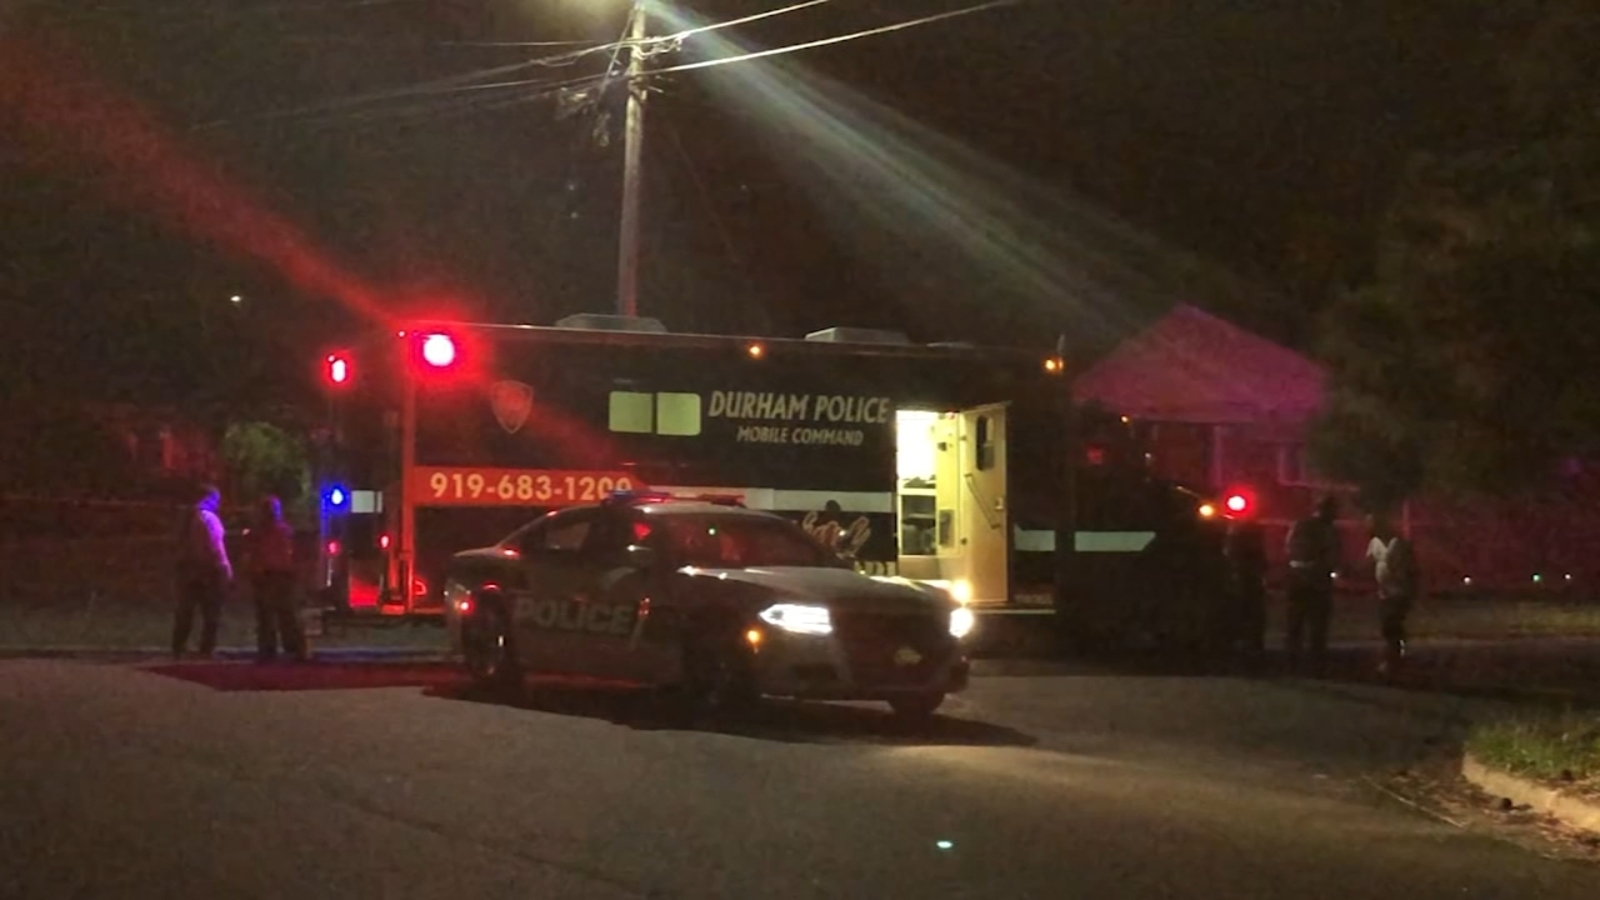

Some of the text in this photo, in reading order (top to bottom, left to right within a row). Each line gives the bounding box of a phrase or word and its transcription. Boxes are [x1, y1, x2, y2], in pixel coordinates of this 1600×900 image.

[708, 390, 889, 423] DURHAM POLICE
[736, 426, 863, 446] MOBILE COMMAND
[511, 595, 635, 635] POLICE
